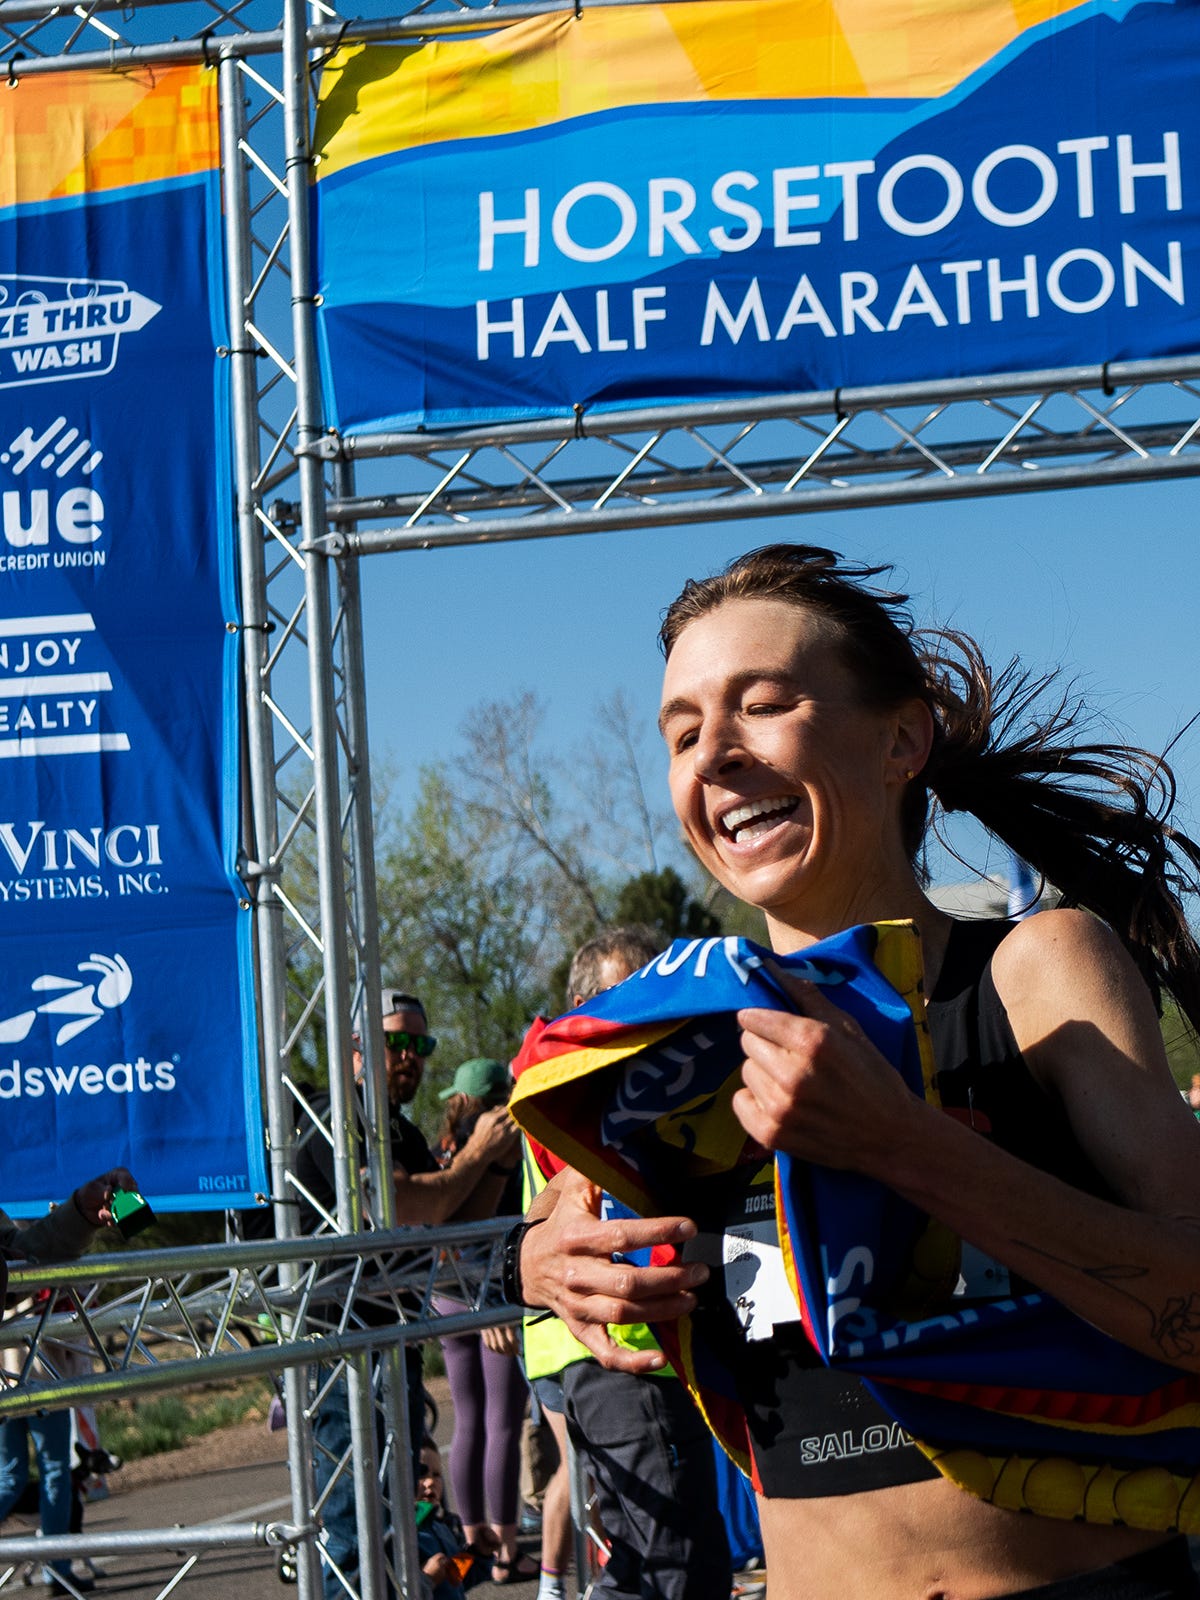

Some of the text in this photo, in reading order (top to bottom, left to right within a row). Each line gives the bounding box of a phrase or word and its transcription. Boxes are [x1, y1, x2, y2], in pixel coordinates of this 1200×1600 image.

[477, 131, 1182, 271] HORSETOOTH
[43, 300, 132, 333] THRU
[476, 241, 1184, 360] HALF MARATHON
[12, 340, 102, 373] WASH
[3, 487, 104, 548] ue
[0, 550, 106, 572] CREDIT UNION
[118, 871, 169, 896] INC.
[199, 1175, 248, 1192] RIGHT
